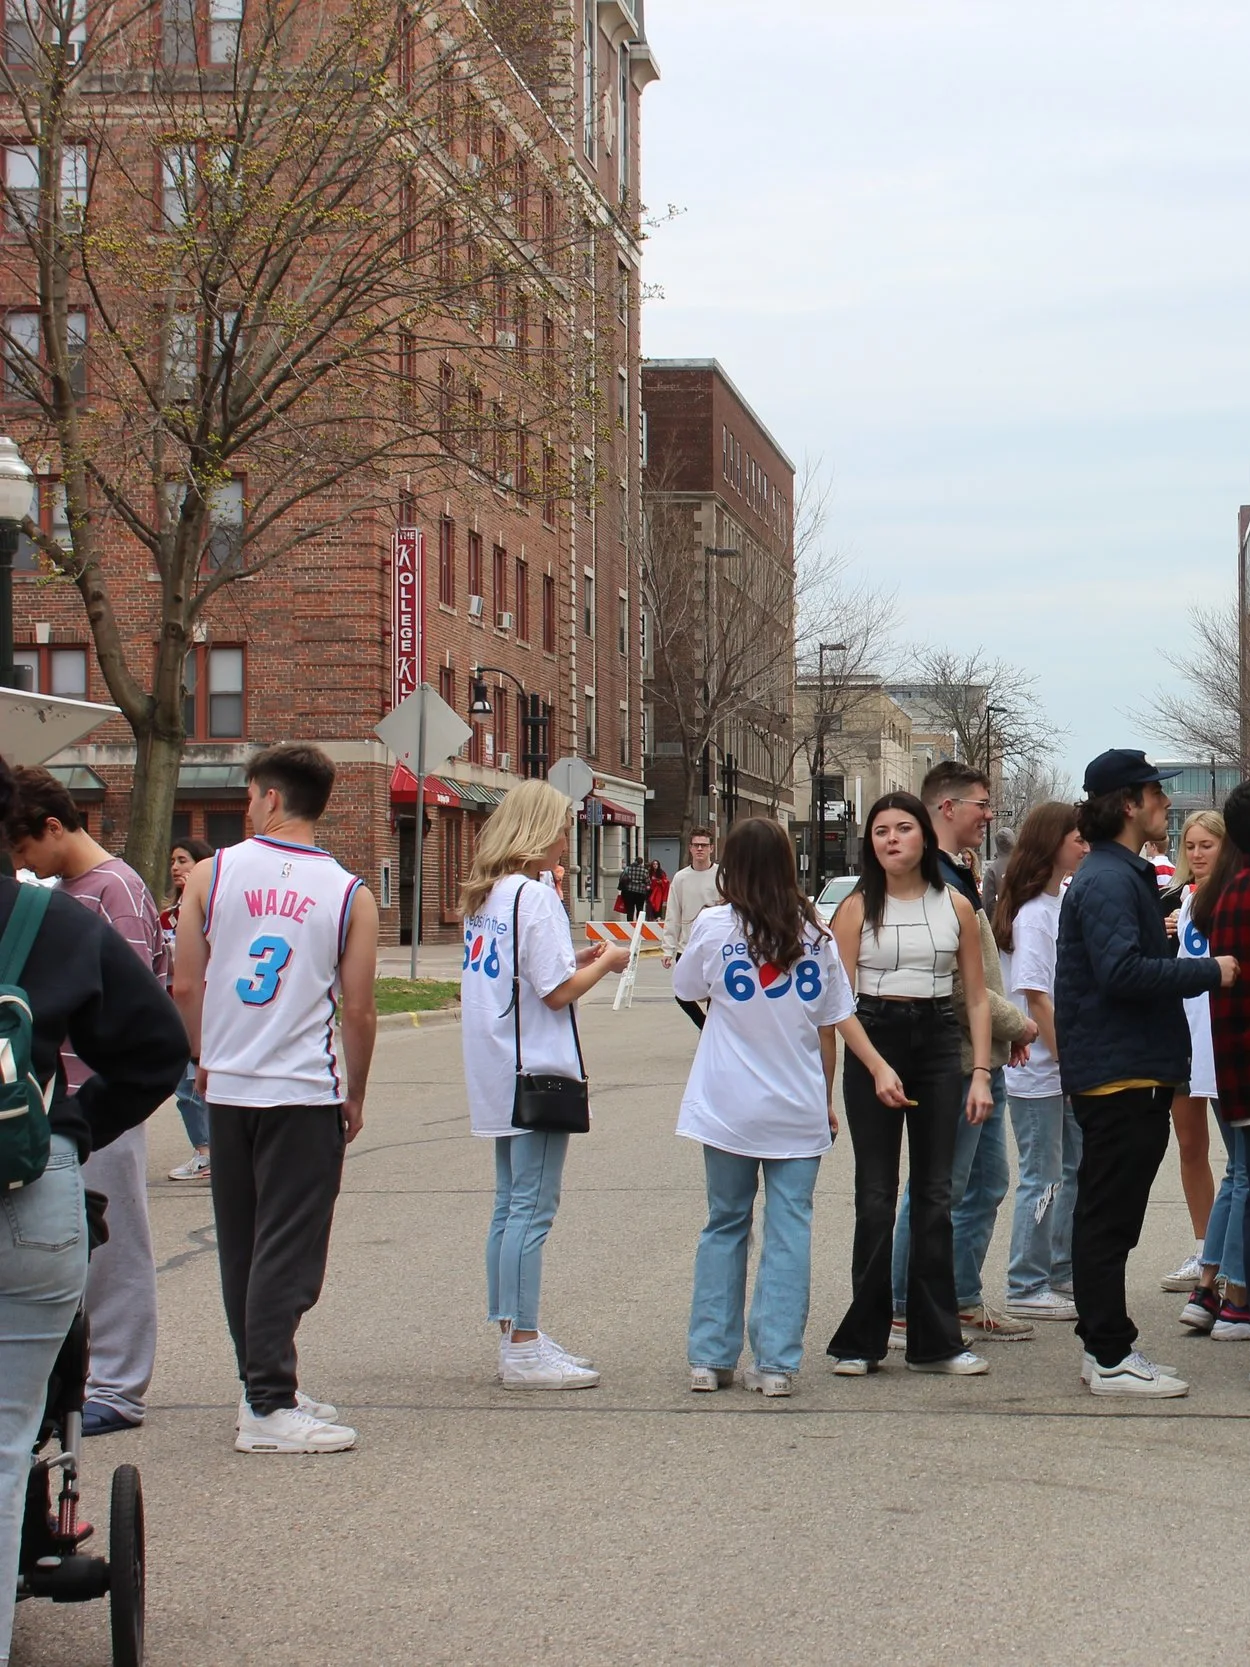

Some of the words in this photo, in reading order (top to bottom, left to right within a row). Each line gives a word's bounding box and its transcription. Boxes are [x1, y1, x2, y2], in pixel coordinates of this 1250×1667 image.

[399, 531, 415, 540] THE
[397, 543, 415, 652] KOLLEGE
[396, 656, 417, 703] KL
[244, 889, 316, 925] WADE
[235, 933, 293, 1008] 3
